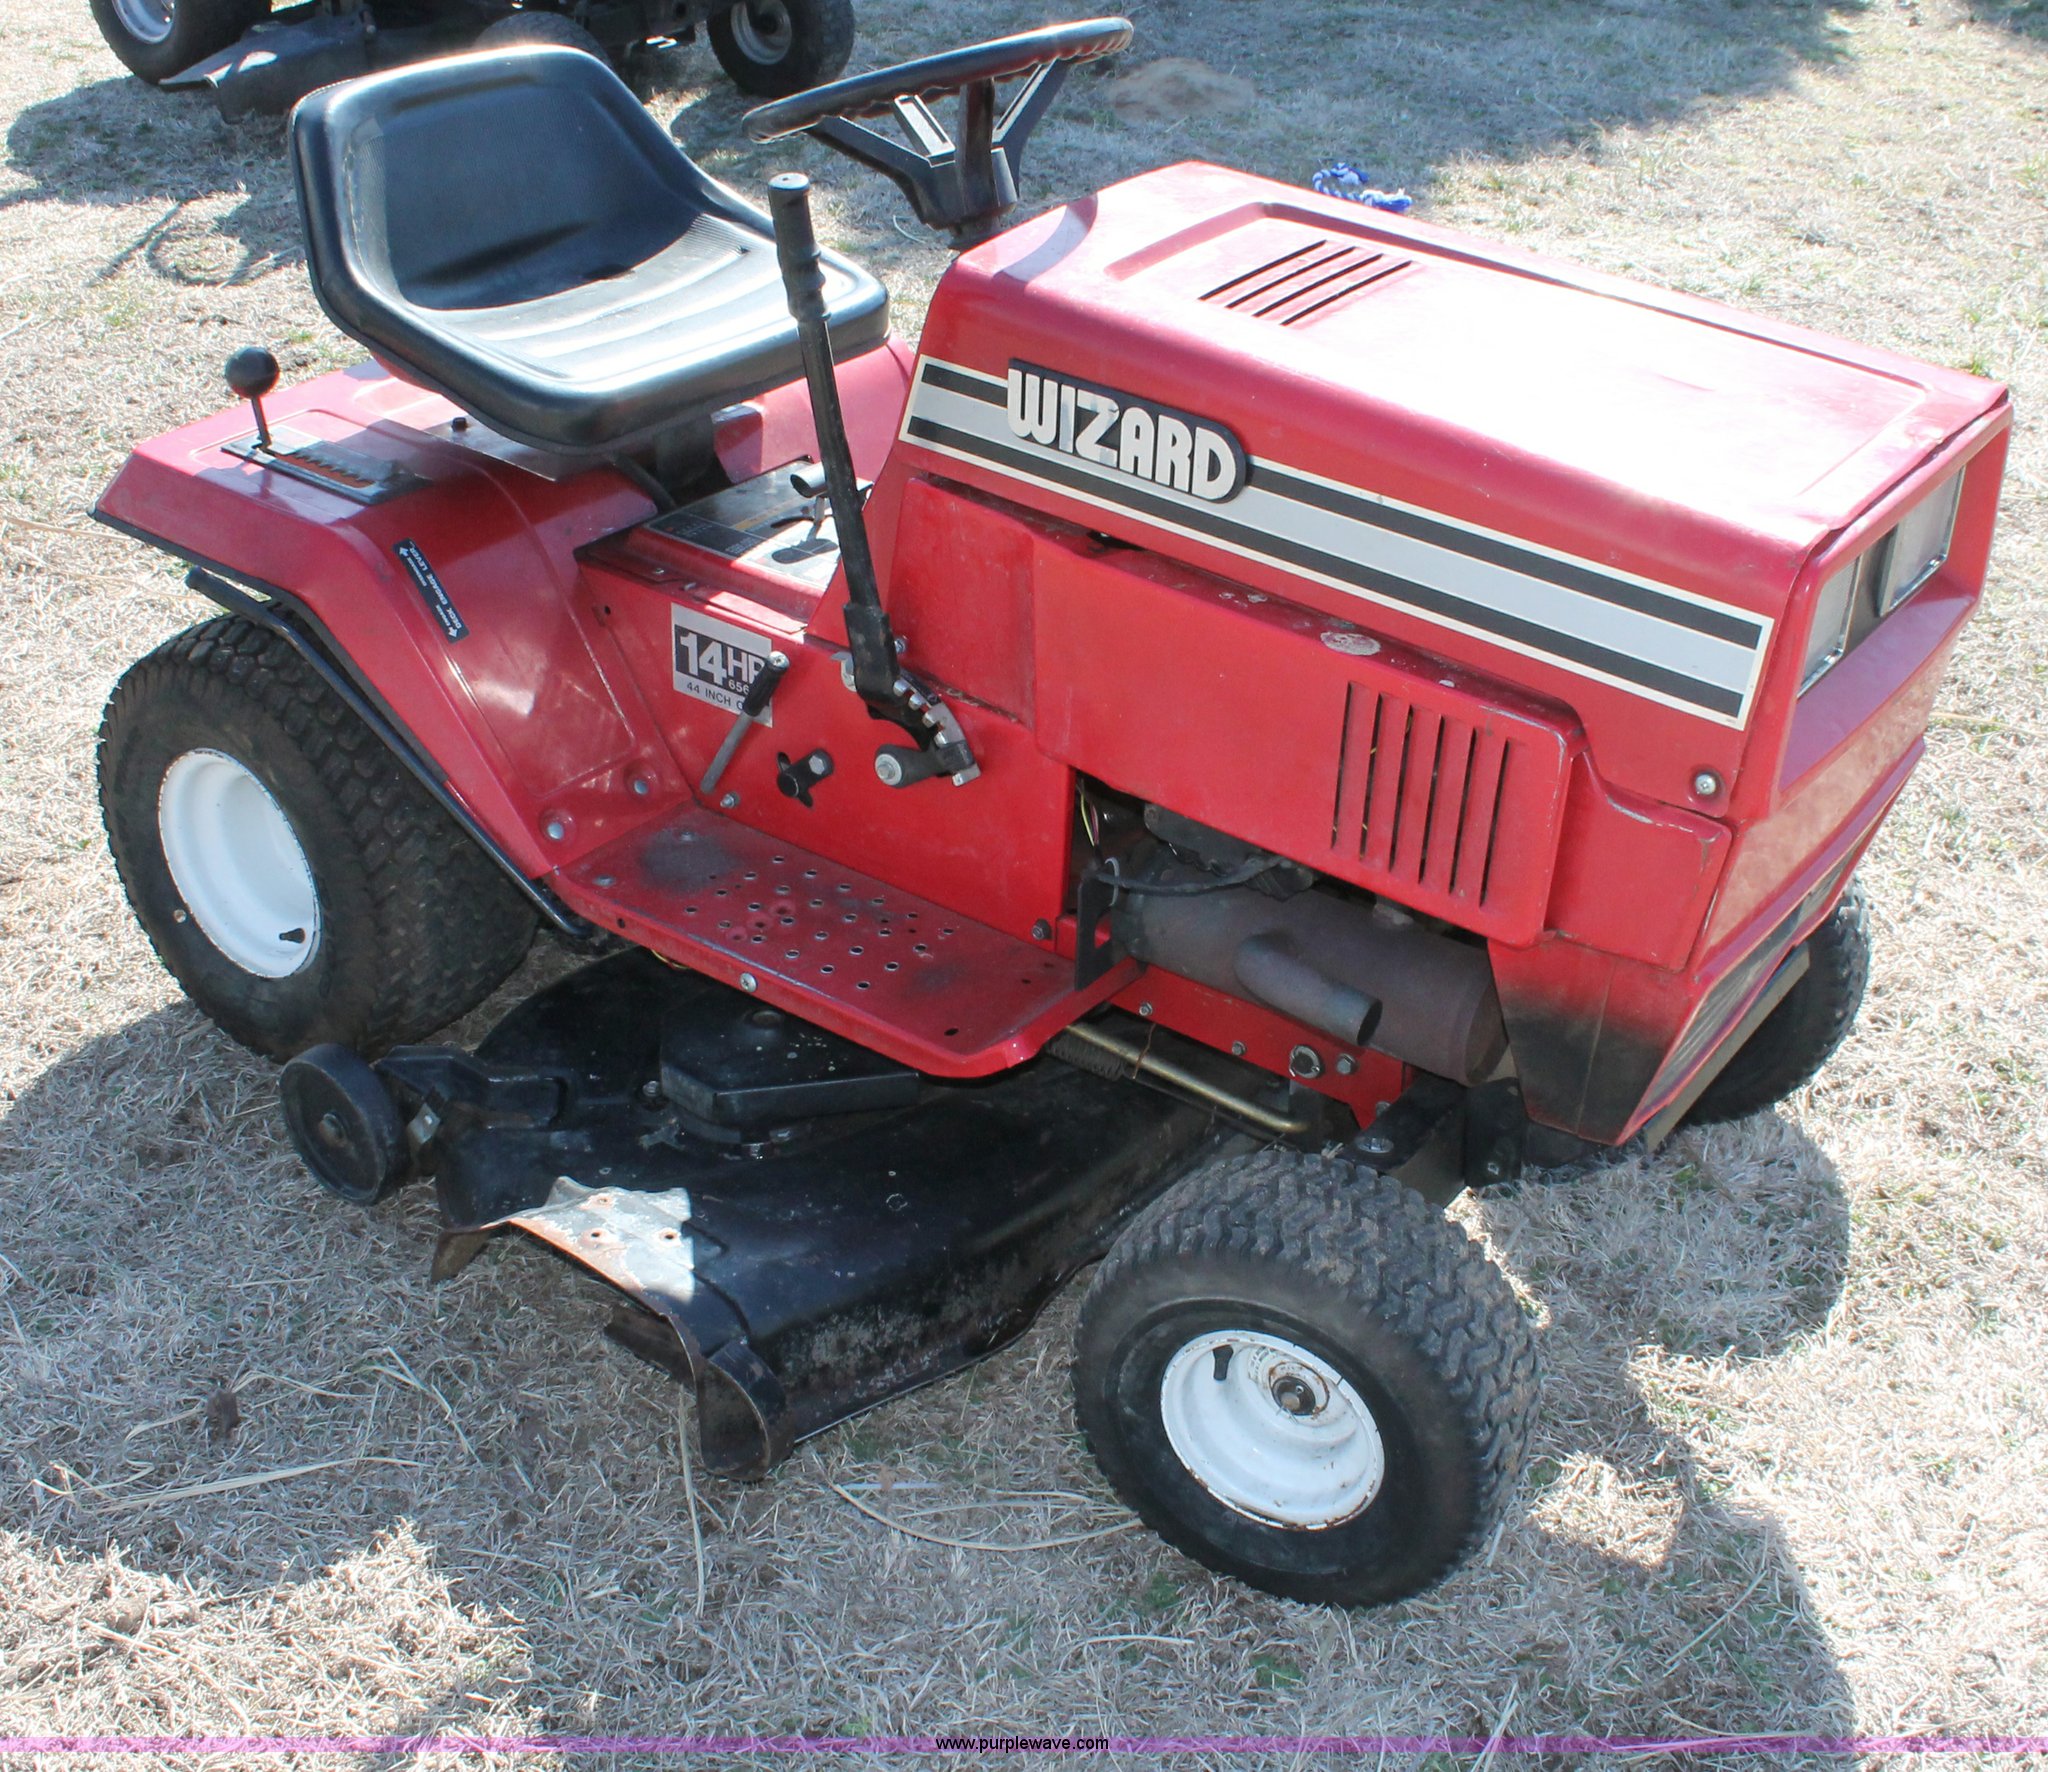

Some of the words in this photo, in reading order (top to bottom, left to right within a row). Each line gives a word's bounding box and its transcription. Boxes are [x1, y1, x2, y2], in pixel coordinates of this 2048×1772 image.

[1007, 367, 1237, 500] WIZARD
[427, 574, 447, 604] ENGAGE
[447, 608, 462, 628] DECK
[687, 682, 700, 694] 44
[705, 688, 731, 707] INCH
